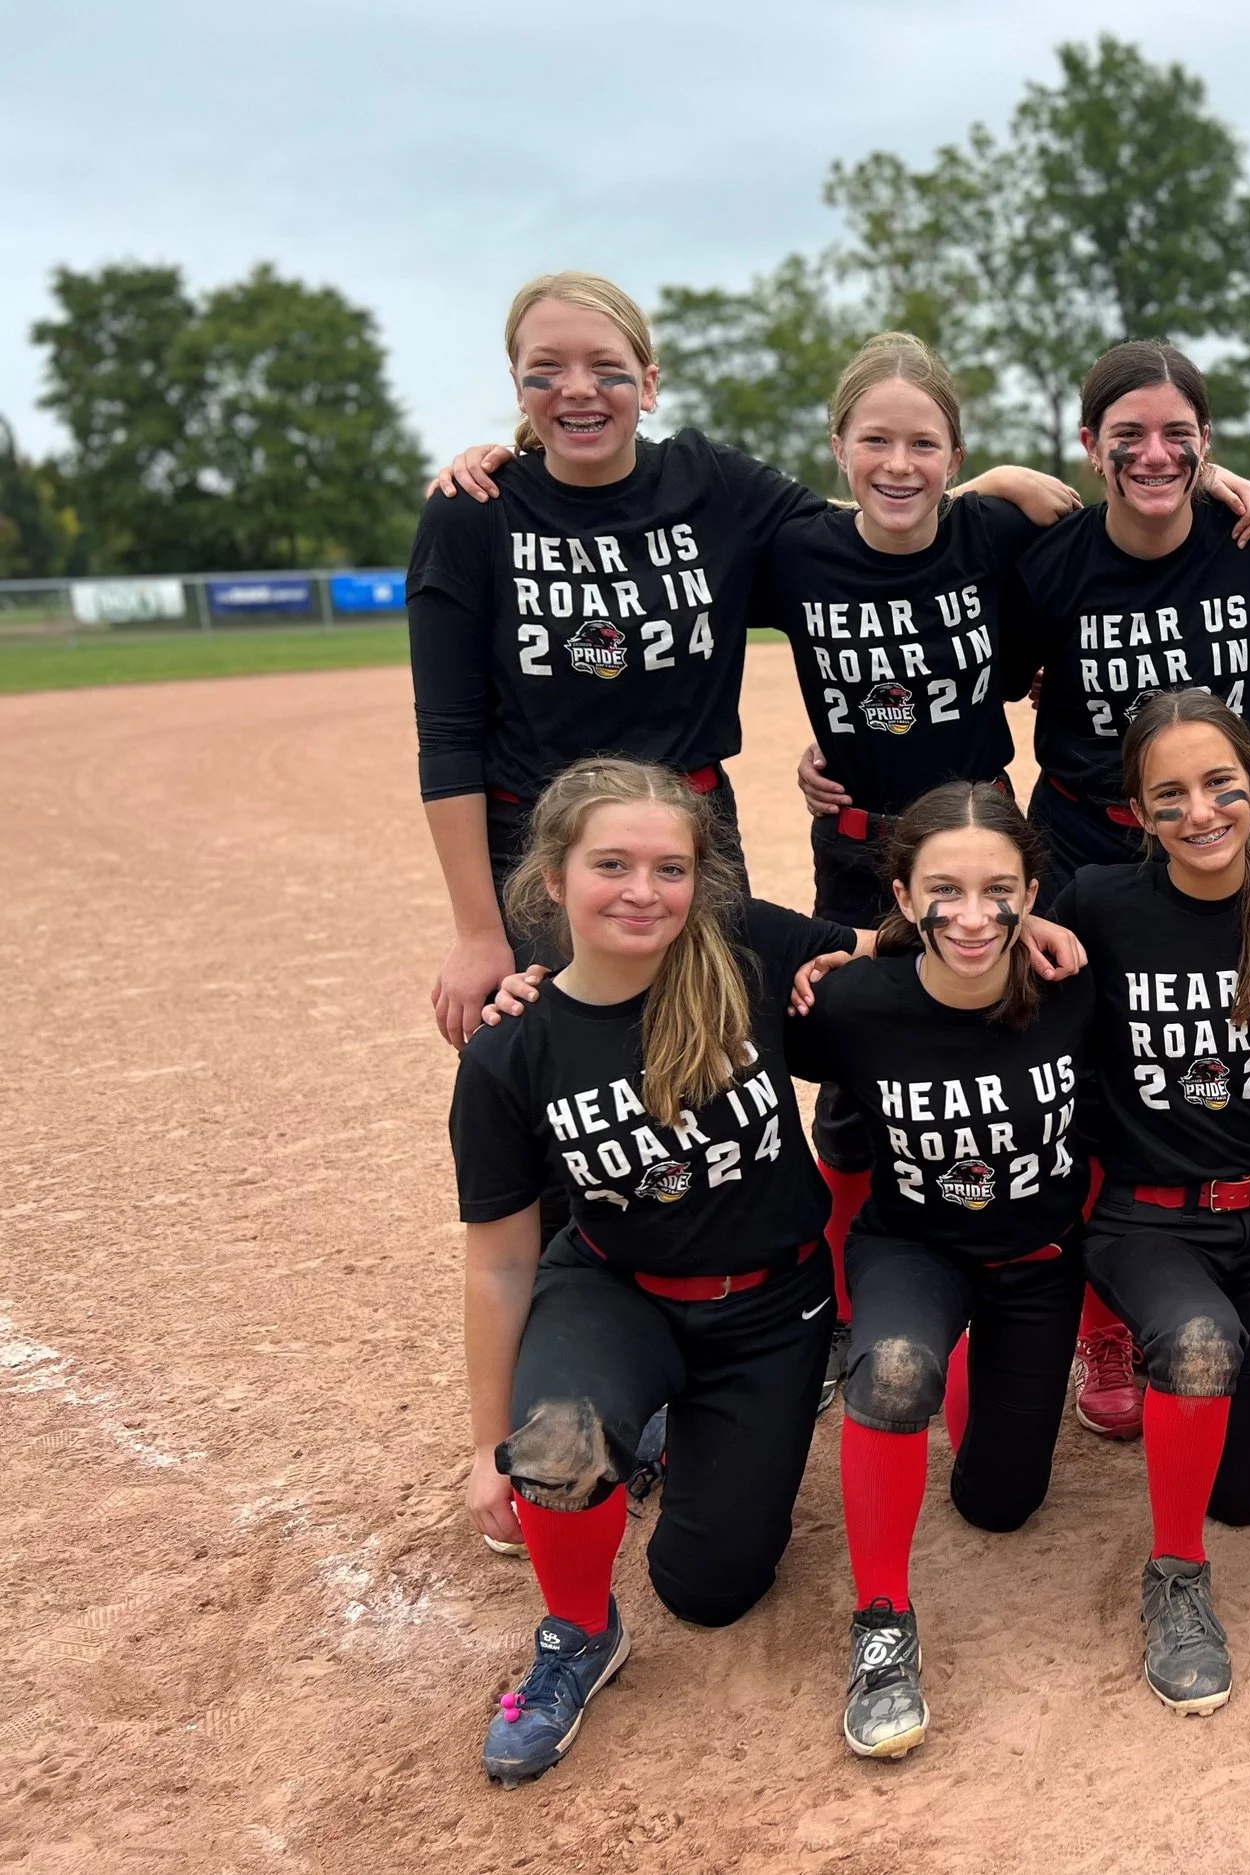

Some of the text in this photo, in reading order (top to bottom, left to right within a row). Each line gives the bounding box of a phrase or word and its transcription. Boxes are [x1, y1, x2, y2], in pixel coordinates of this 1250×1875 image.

[511, 524, 698, 574] HEAR US
[513, 569, 712, 617] ROAR IN
[802, 585, 980, 638] HEAR US
[518, 612, 714, 675] 2 24
[1080, 595, 1247, 649] HEAR US
[572, 648, 623, 664] PRIDE
[813, 625, 992, 682] ROAR IN
[1080, 639, 1248, 692] ROAR IN
[824, 665, 990, 733] 2 24
[866, 707, 912, 720] PRIDE
[1087, 700, 1118, 736] 2
[1125, 970, 1239, 1011] HEAR
[1129, 1019, 1250, 1057] ROAR
[547, 1070, 645, 1141] HEA
[877, 1055, 1075, 1121] HEAR US
[1134, 1065, 1170, 1109] 2
[1186, 1081, 1226, 1096] PRIDE
[562, 1071, 778, 1186] ROAR IN
[705, 1115, 781, 1188] 24
[887, 1098, 1074, 1160] ROAR IN
[894, 1136, 1073, 1204] 2 24
[943, 1184, 991, 1197] PRIDE
